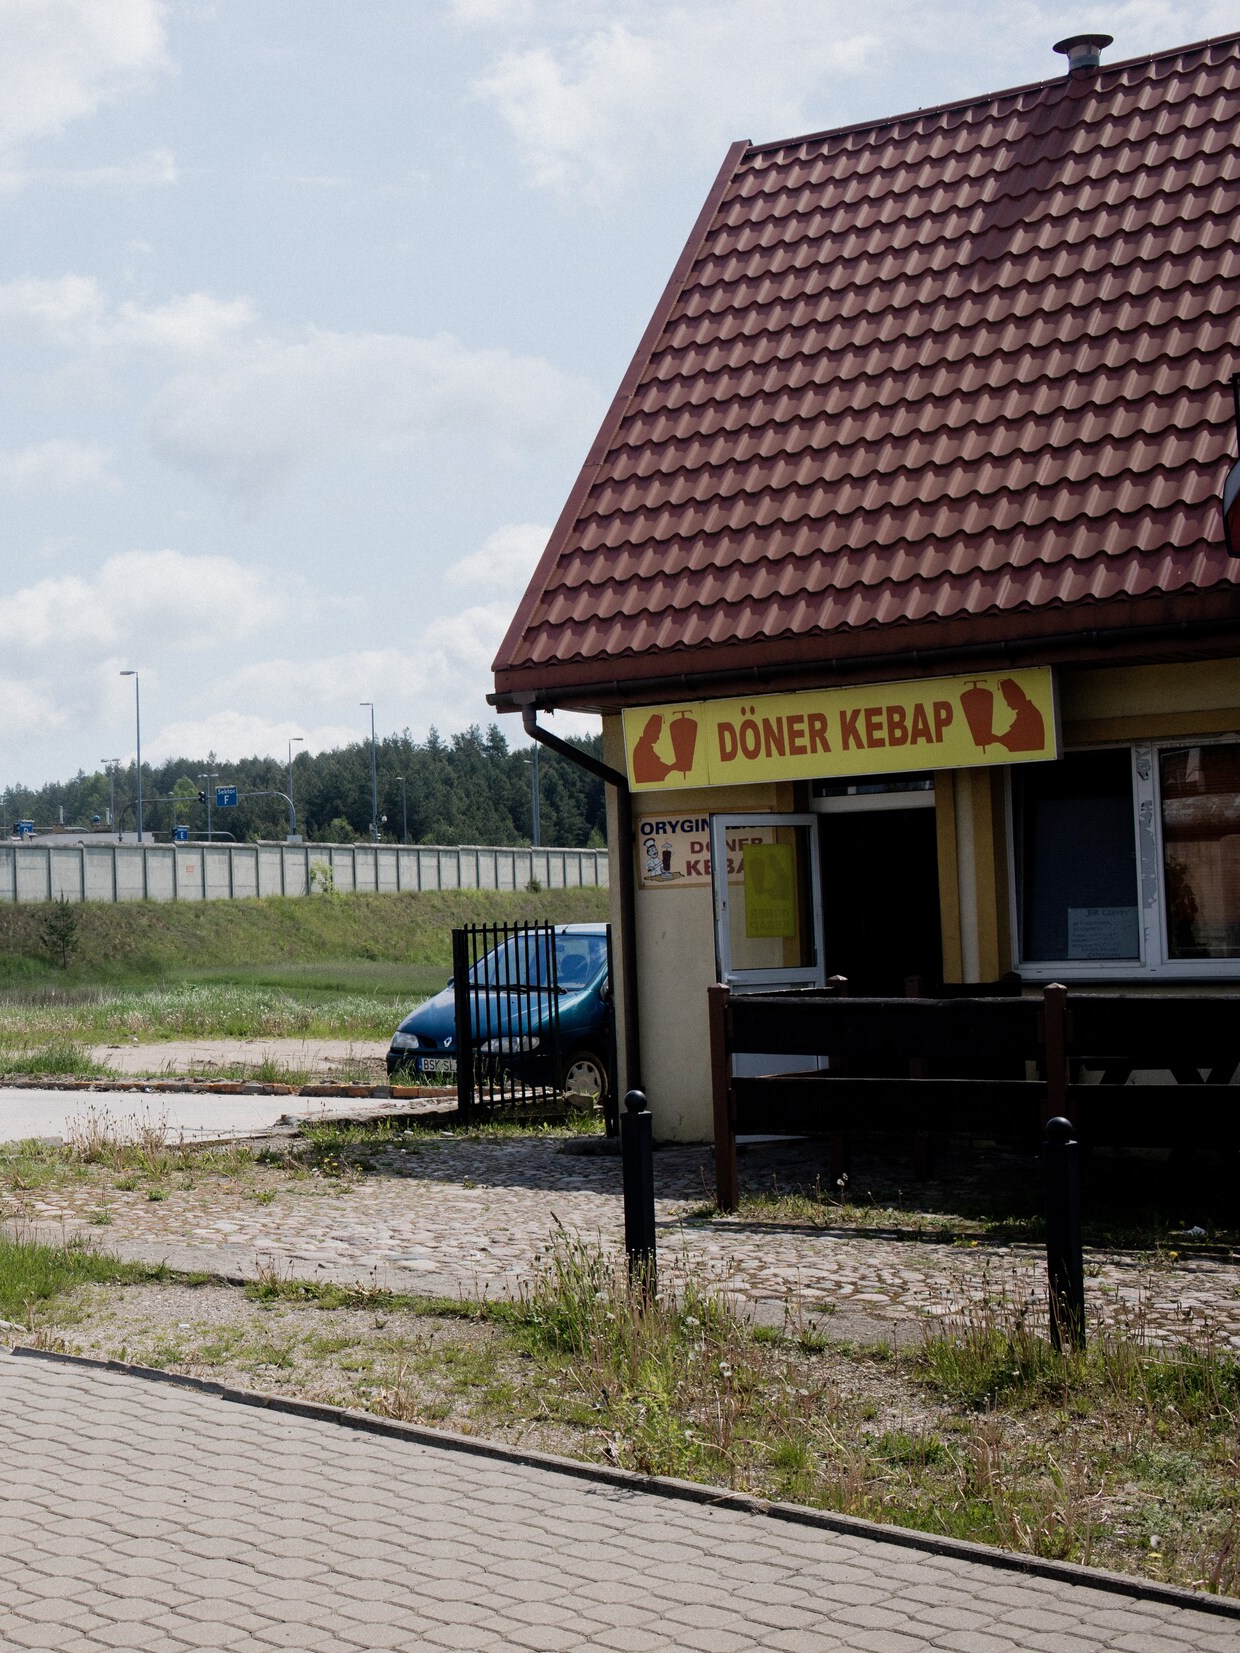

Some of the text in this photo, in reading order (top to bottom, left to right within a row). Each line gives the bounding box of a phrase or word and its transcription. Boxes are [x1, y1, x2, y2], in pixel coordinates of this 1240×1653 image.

[717, 700, 953, 762] DÖNER KEBAP
[224, 796, 230, 805] F
[690, 837, 764, 854] DNER
[686, 857, 745, 877] KEBA
